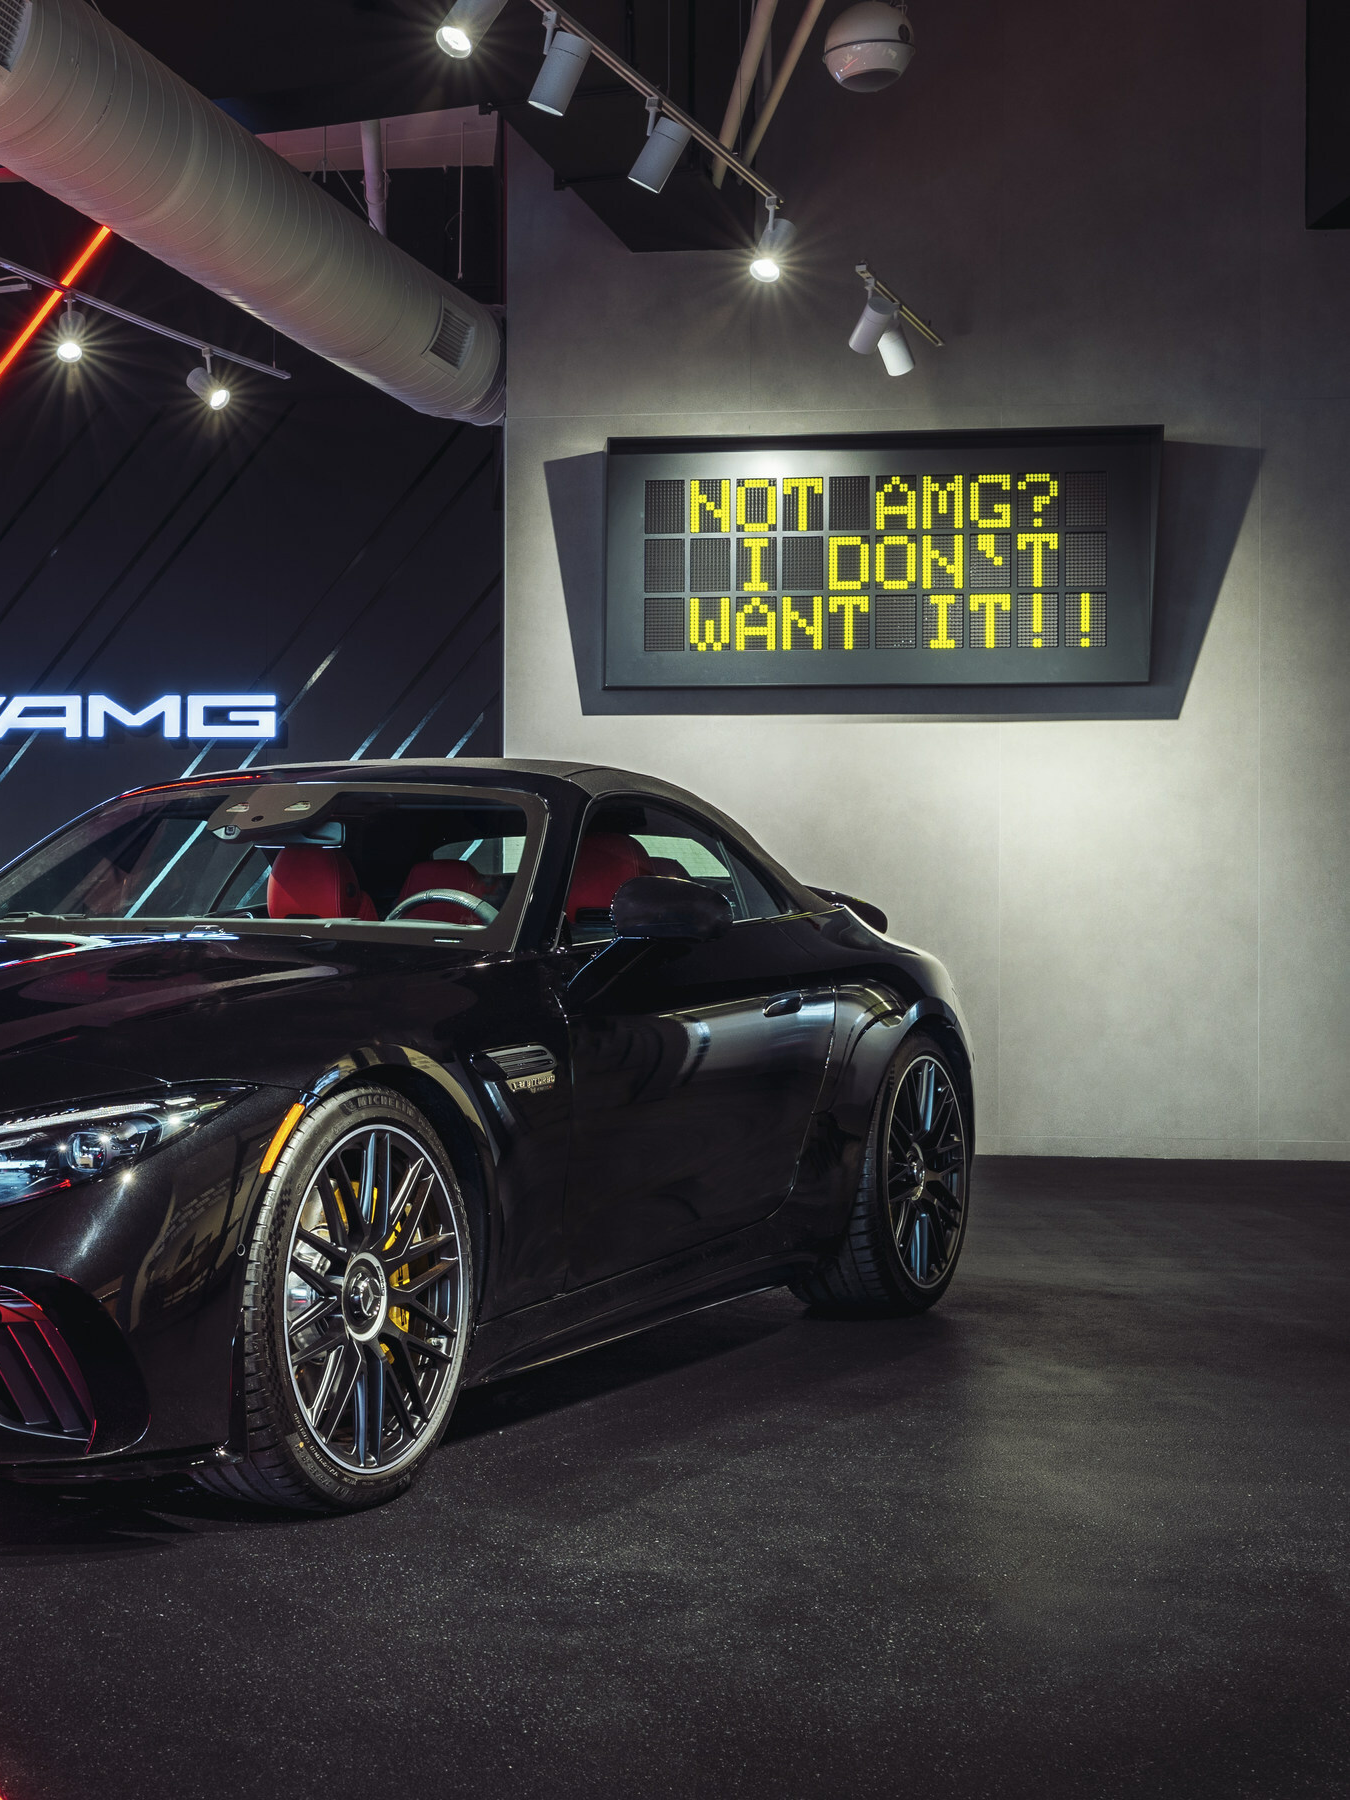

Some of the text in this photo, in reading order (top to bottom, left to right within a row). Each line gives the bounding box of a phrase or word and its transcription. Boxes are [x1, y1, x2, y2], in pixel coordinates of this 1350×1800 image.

[691, 474, 1060, 534] NOT AMG?
[744, 533, 1060, 593] I DON'T
[690, 593, 1092, 653] WANT IT!!
[357, 1094, 415, 1117] MICHELIN
